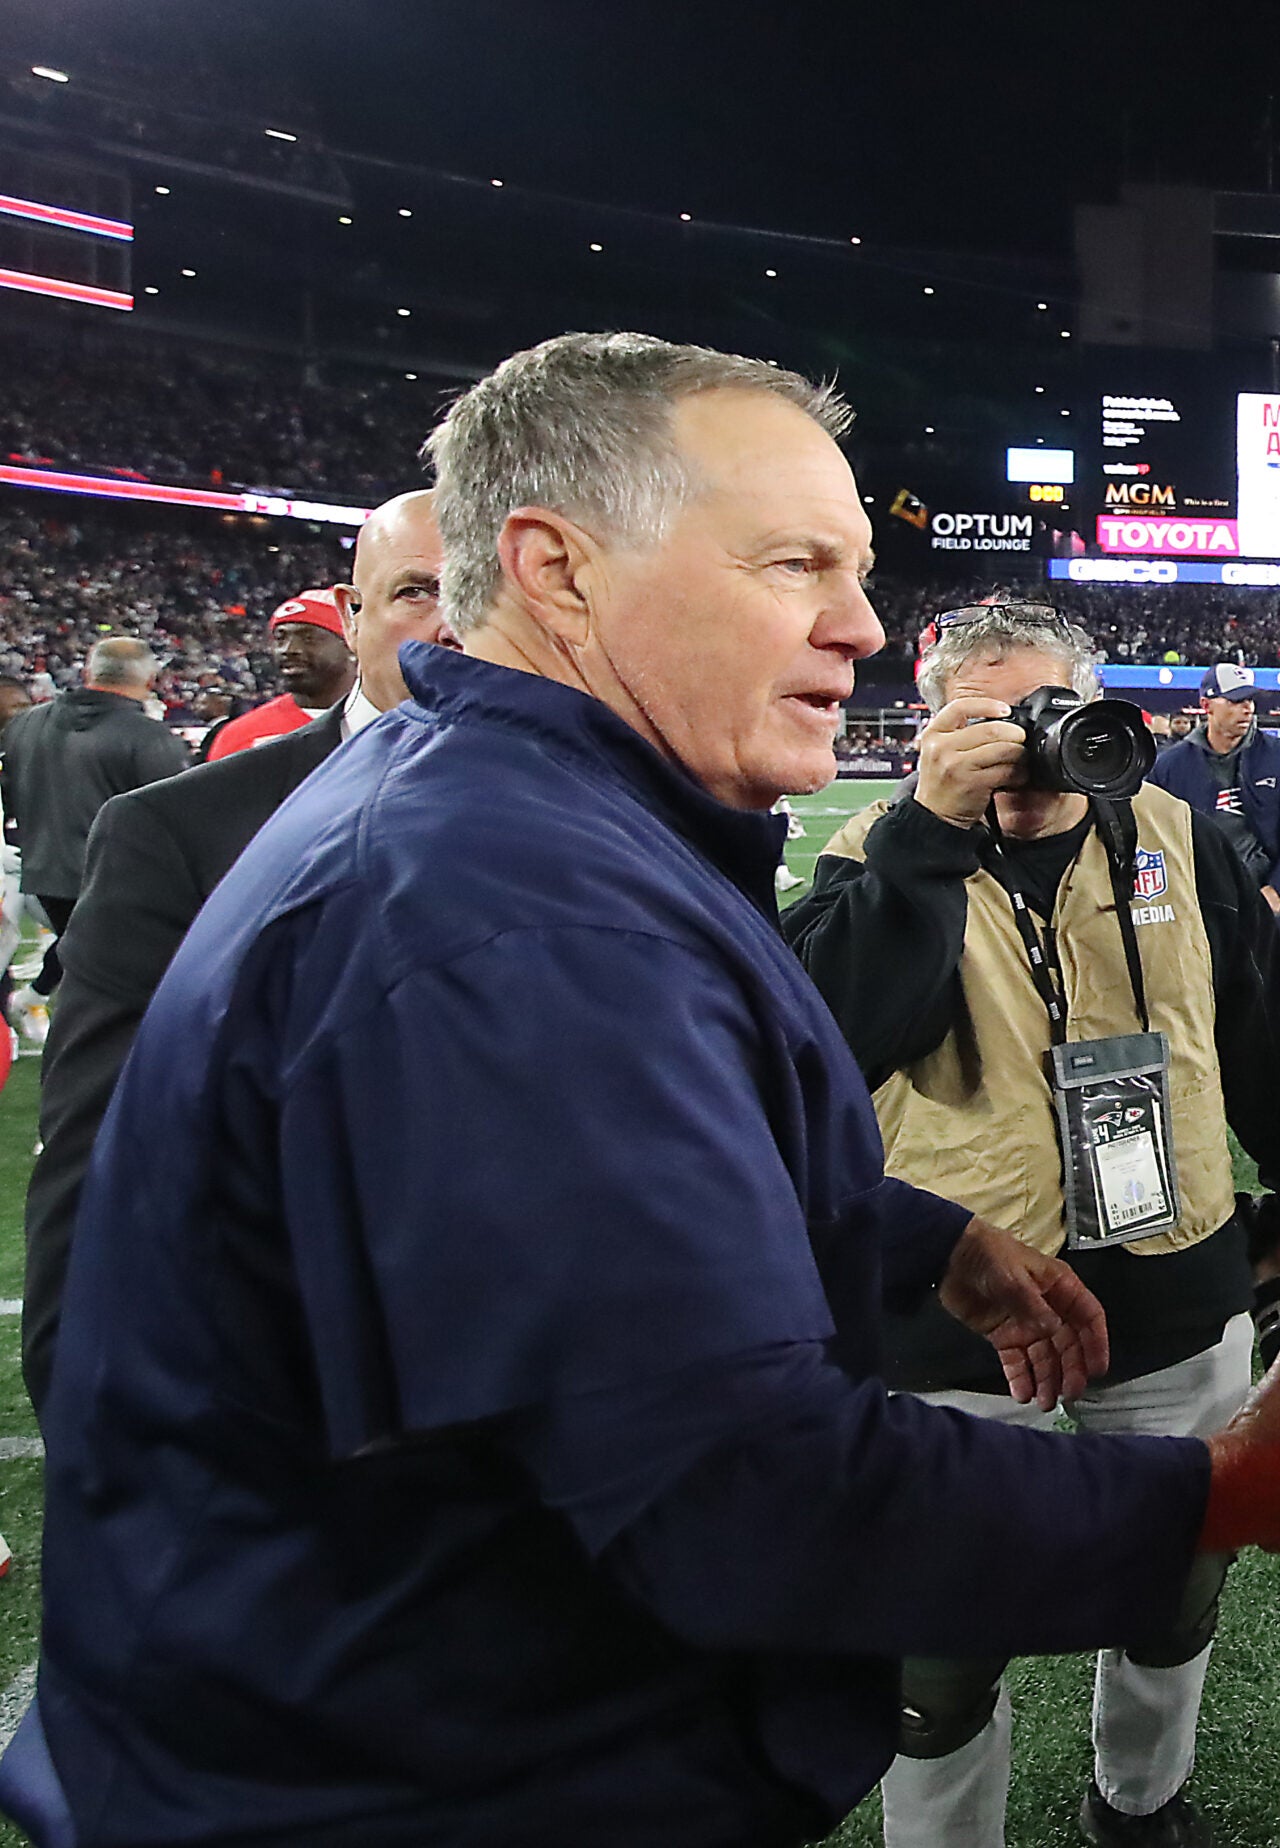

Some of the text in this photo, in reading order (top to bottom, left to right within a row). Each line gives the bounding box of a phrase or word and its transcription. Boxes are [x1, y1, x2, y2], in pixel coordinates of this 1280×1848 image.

[1105, 483, 1176, 505] MGM
[932, 513, 1033, 536] OPTUM
[932, 537, 1031, 551] FIELD LOUNGE
[1101, 521, 1236, 551] TOYOTA
[1068, 558, 1178, 583] GEICO
[1051, 698, 1081, 706] Canon
